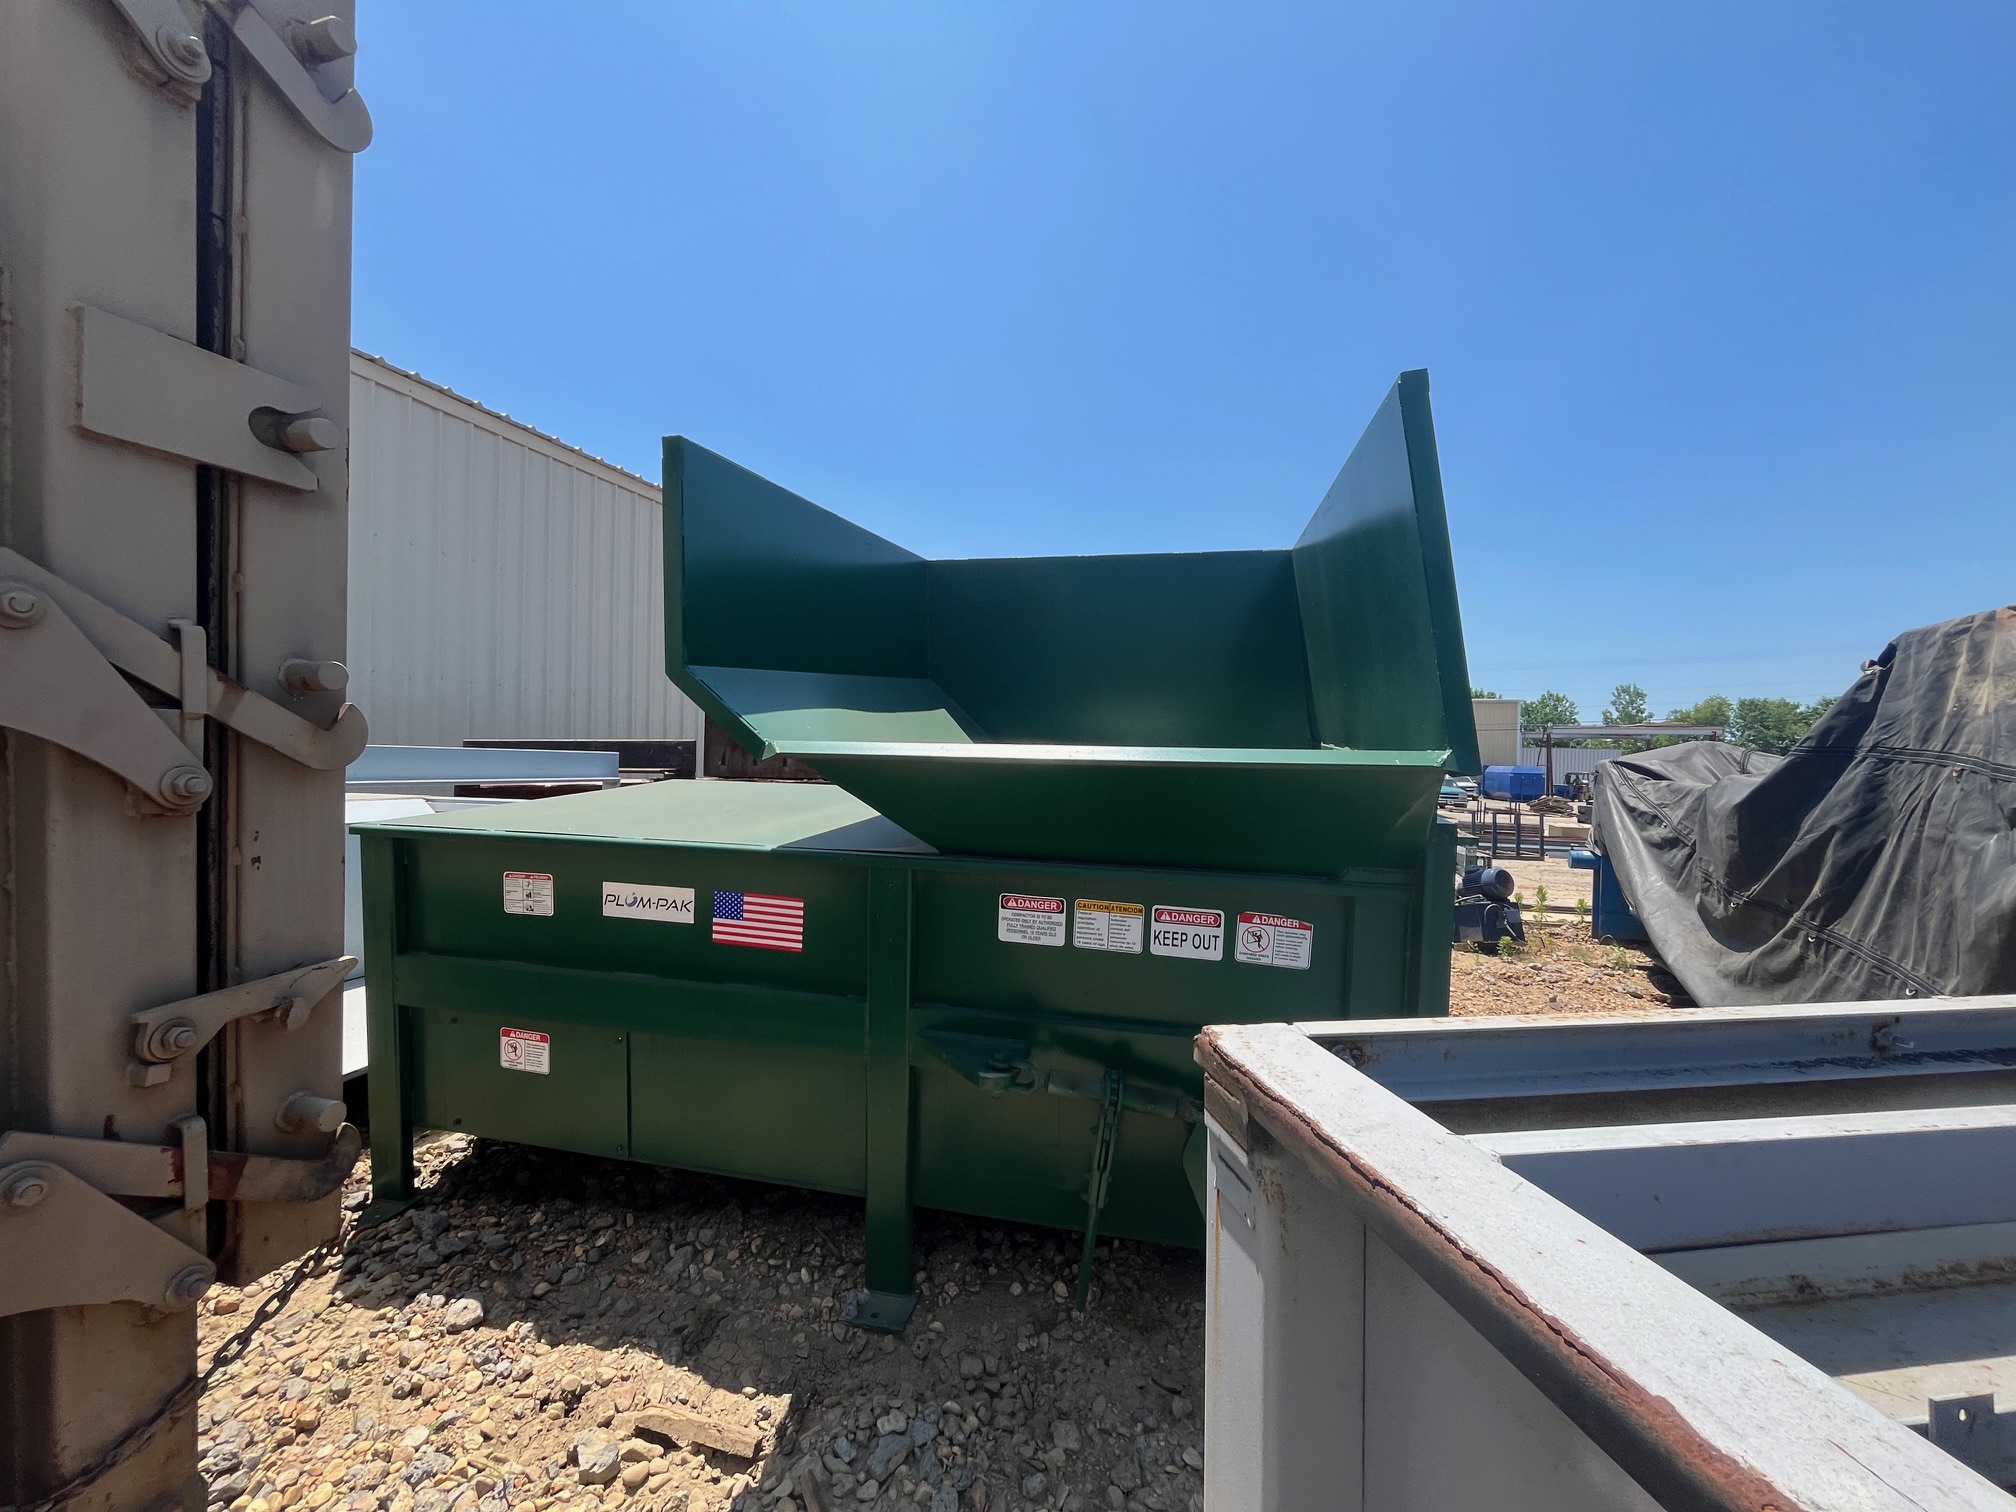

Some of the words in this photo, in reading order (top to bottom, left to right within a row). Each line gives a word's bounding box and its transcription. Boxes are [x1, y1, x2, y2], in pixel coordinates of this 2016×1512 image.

[1018, 900, 1058, 910] DANGER
[1078, 902, 1109, 911] CAUTION
[1110, 905, 1143, 914] ATENCION
[1171, 913, 1215, 924] DANGER
[1262, 916, 1299, 928] DANGER
[1154, 930, 1188, 948] KEEP
[1192, 934, 1220, 951] OUT
[516, 1032, 540, 1041] DANGER
